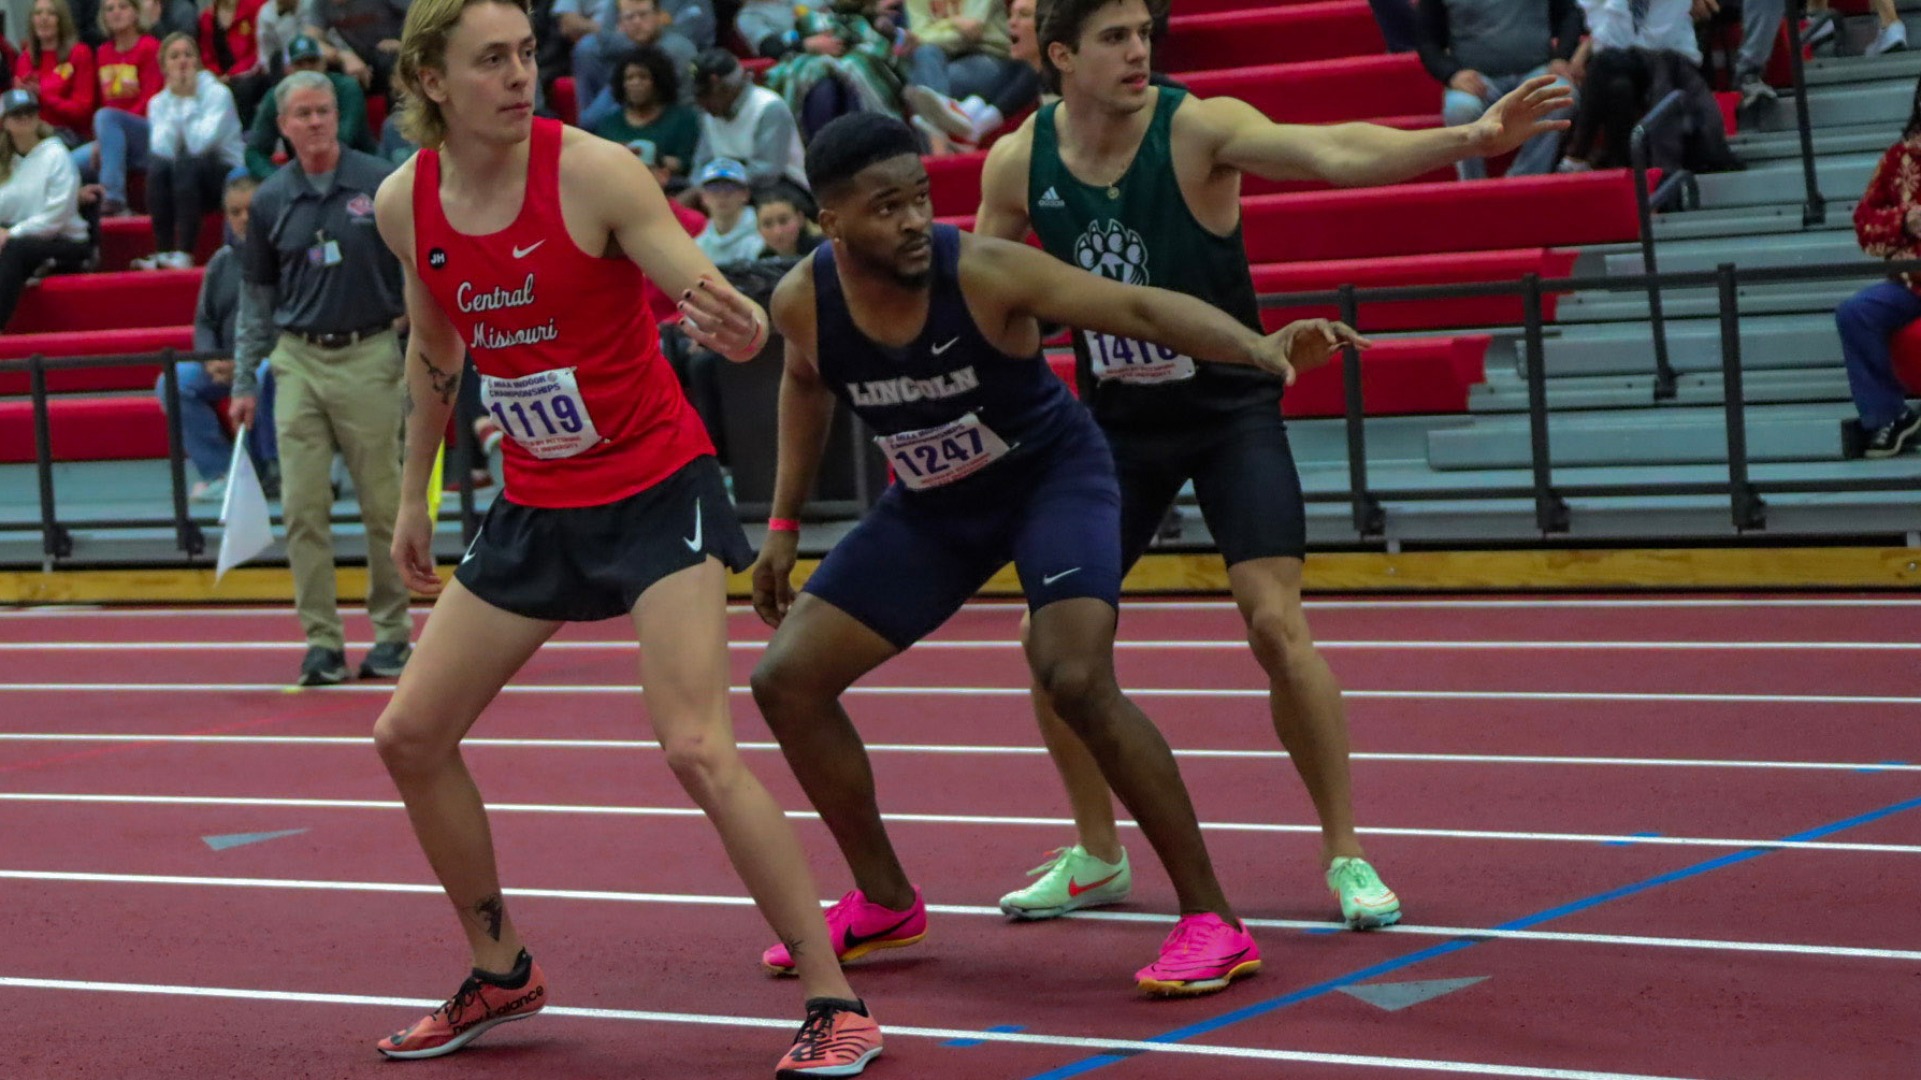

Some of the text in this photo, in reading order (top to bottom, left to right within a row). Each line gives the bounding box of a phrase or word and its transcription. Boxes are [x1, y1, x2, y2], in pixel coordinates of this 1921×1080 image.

[430, 254, 446, 264] JH
[457, 273, 534, 313] Central
[470, 318, 558, 349] Missouri
[489, 383, 561, 397] CHAMPIONSHIPS
[513, 375, 546, 388] INDOOR
[846, 366, 980, 406] LINCOLN
[491, 395, 583, 437] 1119
[895, 427, 983, 477] 1247
